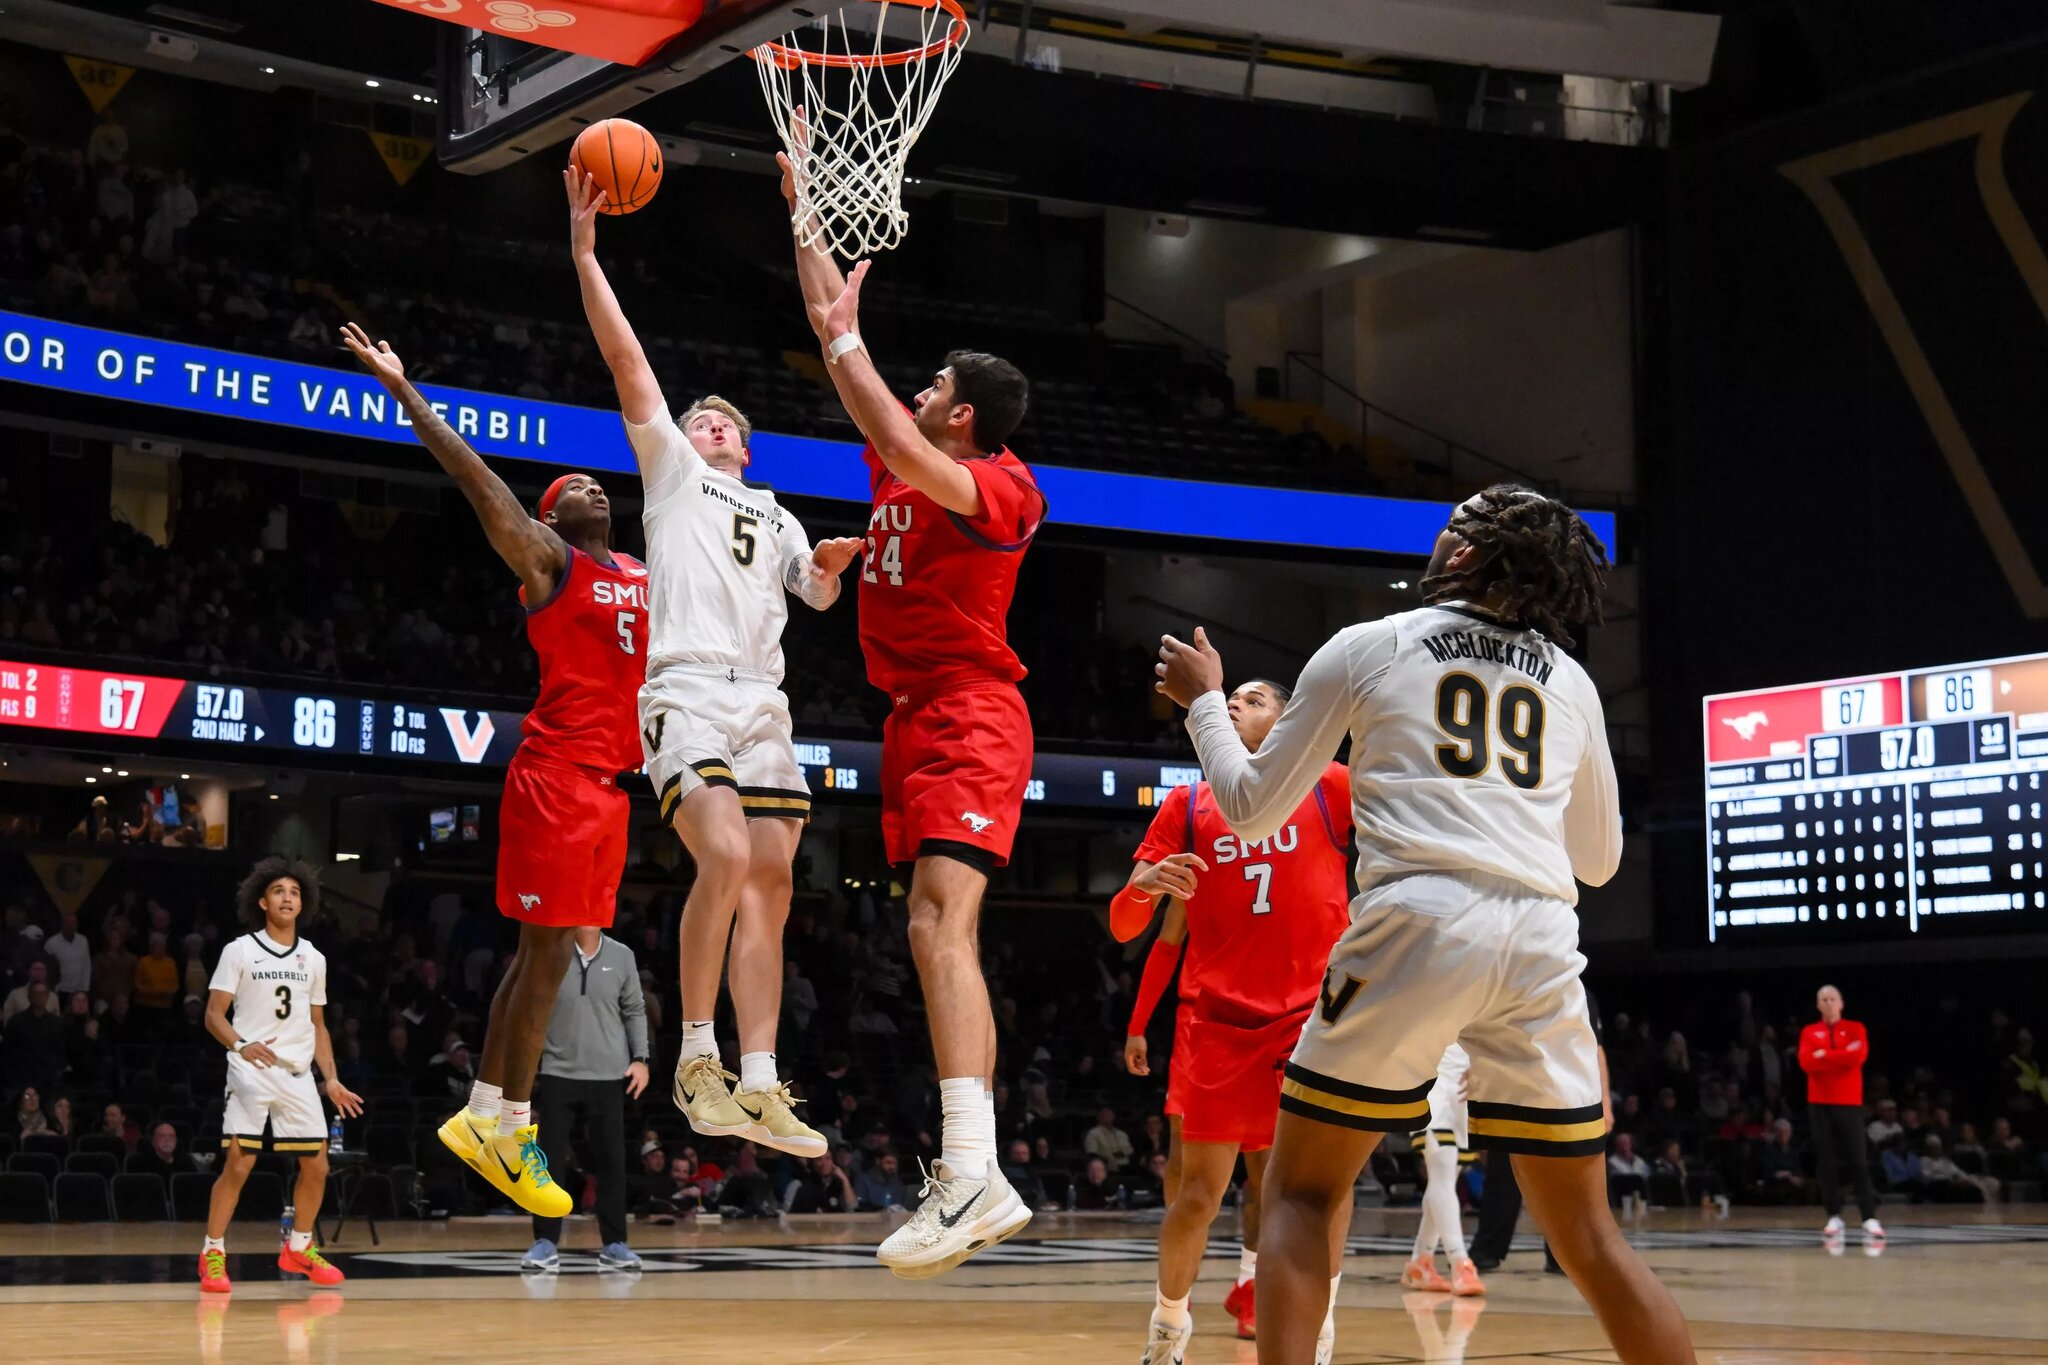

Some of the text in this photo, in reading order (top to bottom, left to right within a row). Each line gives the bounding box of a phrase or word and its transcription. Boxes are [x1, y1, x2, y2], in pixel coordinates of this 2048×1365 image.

[4, 331, 65, 371] OR
[97, 348, 156, 385] OF
[184, 362, 271, 405] THE
[731, 511, 759, 567] 5
[863, 534, 904, 587] 24
[616, 610, 637, 656] 5
[1421, 630, 1554, 687] MCGLOCKTON
[1, 667, 39, 692] TOL 2
[1944, 674, 1976, 713] 86
[0, 694, 37, 719] FLS 9
[100, 677, 146, 731] 67
[196, 683, 245, 722] 57.0
[393, 704, 427, 731] 3 TOL
[1839, 688, 1866, 726] 67
[191, 718, 248, 743] 2ND HALF
[293, 696, 337, 749] 86
[361, 704, 374, 751] BONUS
[1433, 669, 1547, 791] 99
[390, 730, 426, 755] 10 FLS
[1879, 725, 1936, 771] 57.0
[835, 767, 858, 790] FLS
[1213, 825, 1298, 864] SMU
[1243, 862, 1273, 915] 7
[251, 970, 309, 982] VANDERBILT
[274, 984, 292, 1021] 3
